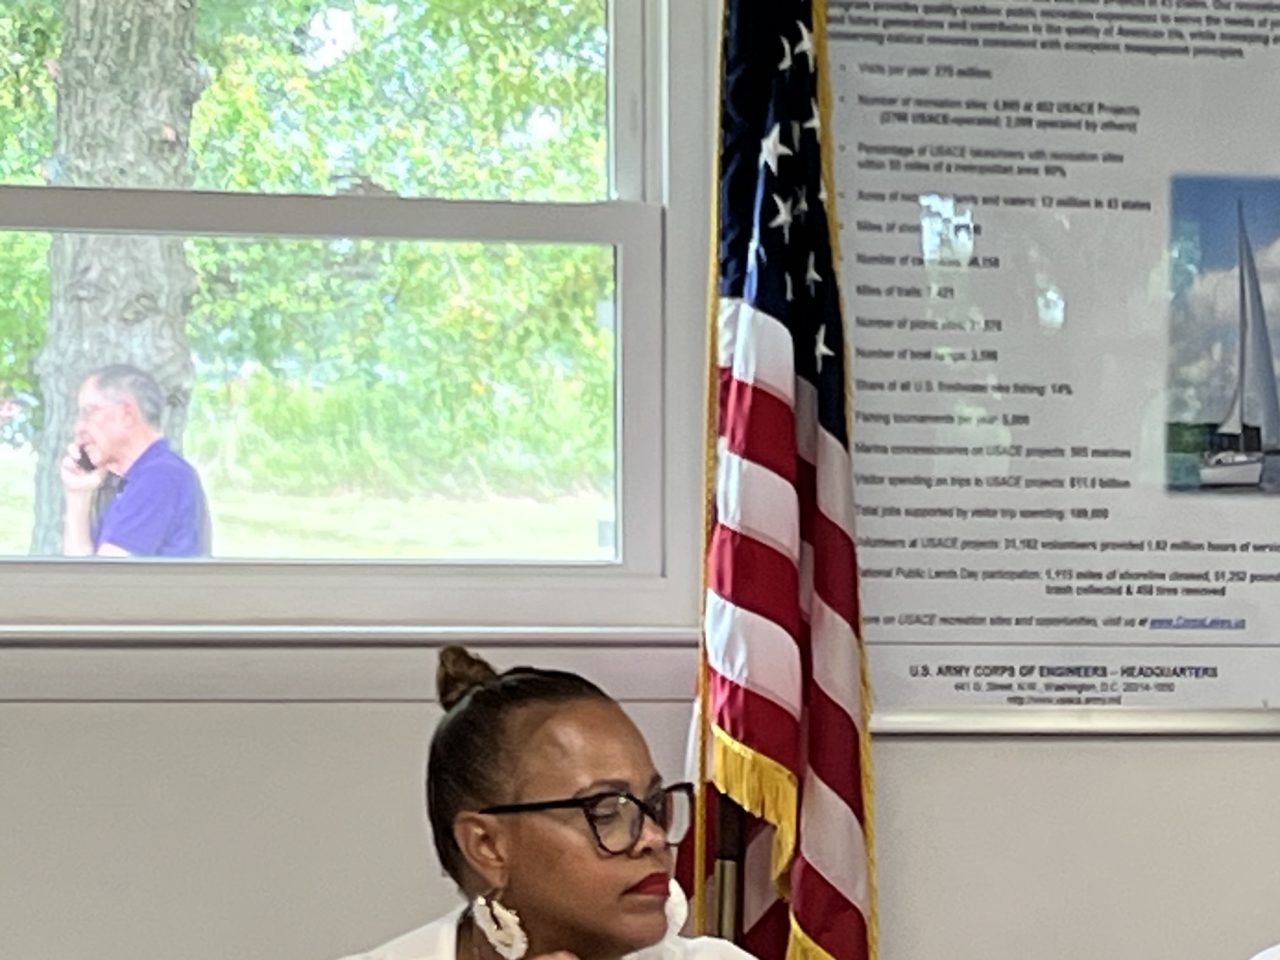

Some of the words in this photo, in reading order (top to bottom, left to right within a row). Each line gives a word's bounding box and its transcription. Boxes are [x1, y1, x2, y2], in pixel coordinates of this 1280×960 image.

[909, 666, 931, 677] U.S.
[936, 666, 970, 676] ARMY
[973, 666, 1015, 677] CORPS
[1019, 665, 1036, 677] OF
[1040, 666, 1107, 677] ENGINEERS
[1121, 666, 1218, 677] HEADQUARTERS
